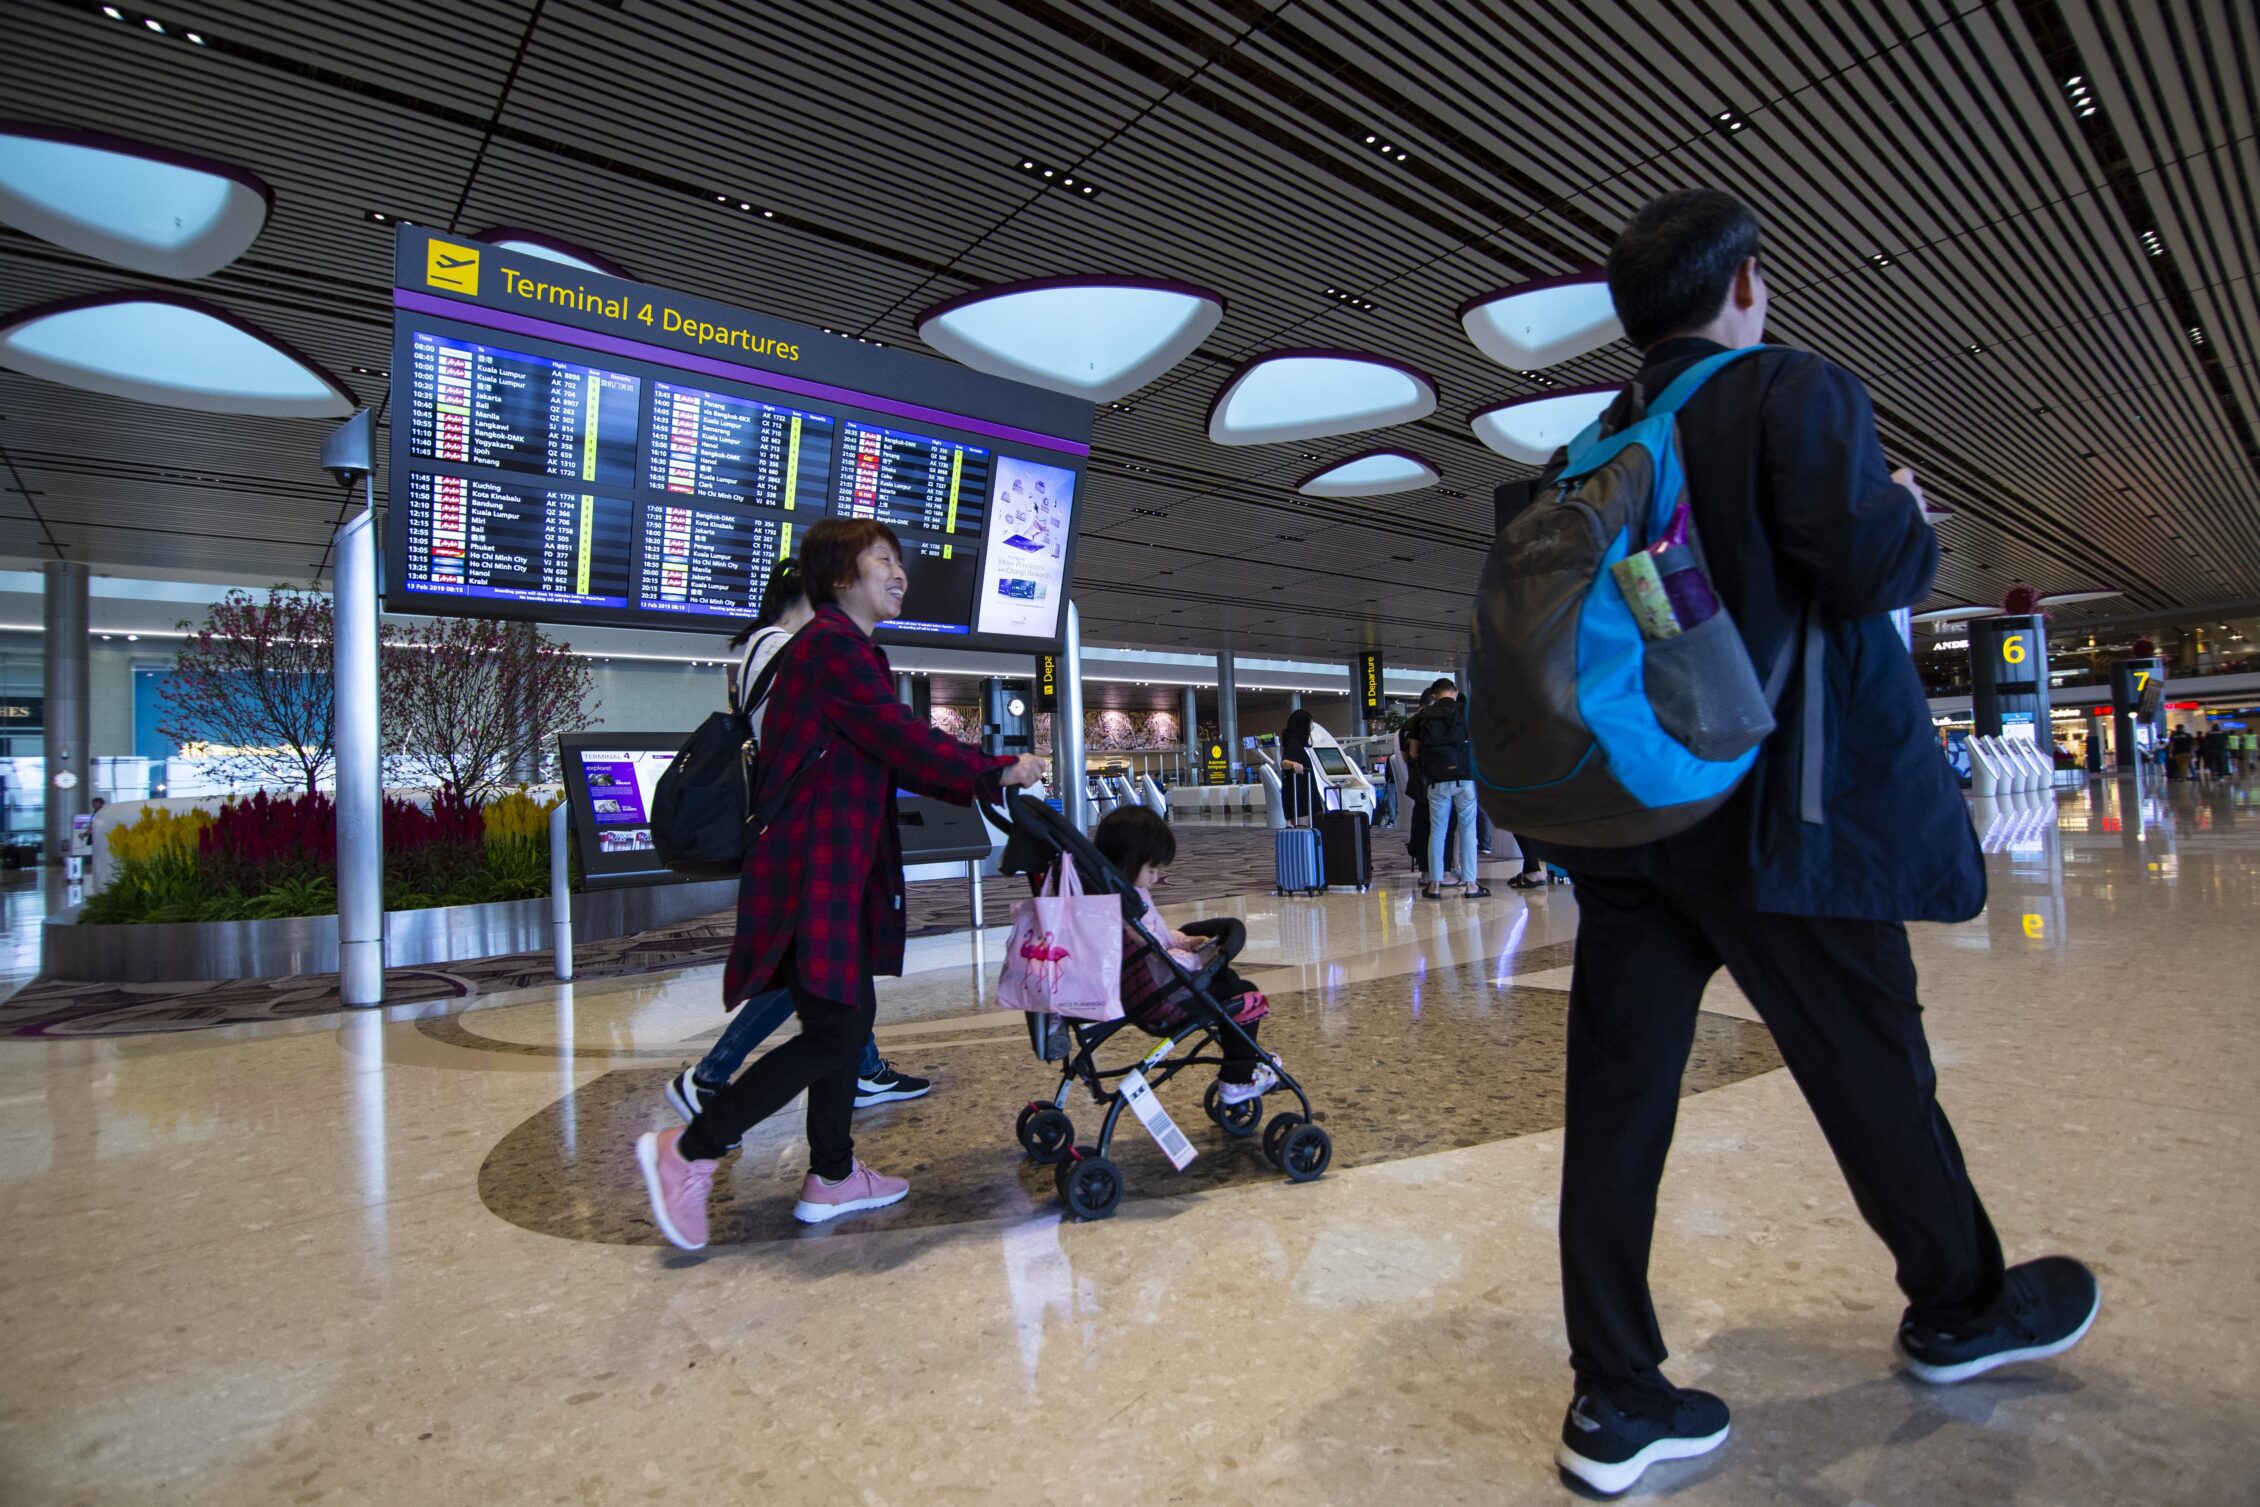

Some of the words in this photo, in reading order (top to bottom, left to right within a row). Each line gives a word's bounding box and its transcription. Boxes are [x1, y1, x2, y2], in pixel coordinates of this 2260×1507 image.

[500, 267, 628, 320] Terminal
[637, 304, 653, 326] 4
[663, 309, 799, 361] Departures
[414, 342, 435, 352] 08:00
[413, 351, 434, 361] 08:45
[476, 363, 497, 374] Kuala
[498, 368, 526, 379] Lumpur
[414, 361, 434, 371] 10:00
[476, 373, 497, 383] Kuala
[498, 377, 525, 388] Lumpur
[413, 371, 434, 380] 10:00
[413, 380, 433, 390] 10:20
[475, 391, 501, 402] Jakarta
[413, 390, 433, 399] 10:35
[475, 400, 489, 409] Bali
[412, 399, 432, 408] 10:40
[474, 410, 500, 420] Manila
[412, 409, 432, 418] 10:45
[474, 419, 509, 430] Langkawi
[411, 428, 432, 437] 11:10
[474, 437, 514, 449] Yogyakarta
[412, 418, 432, 427] 10:55
[474, 428, 524, 442] Bangkok-DMK
[411, 437, 431, 446] 11:40
[473, 446, 490, 455] Ipoh
[411, 446, 431, 455] 11:45
[472, 455, 500, 467] Penang
[410, 473, 430, 481] 11:45
[472, 481, 501, 492] Kuching
[410, 482, 430, 490] 11:45
[471, 490, 489, 498] Kota
[490, 492, 521, 502] Kinabalu
[409, 491, 430, 500] 11:50
[471, 498, 503, 510] Bandung
[409, 500, 429, 508] 12:10
[471, 508, 492, 516] Kuala
[492, 510, 520, 519] Lumpur
[409, 509, 429, 518] 12:15
[470, 516, 486, 524] Miri
[409, 518, 429, 526] 12:15
[408, 527, 428, 535] 12:55
[408, 536, 428, 544] 13:05
[469, 542, 495, 551] Phuket
[408, 545, 428, 553] 13:05
[513, 556, 527, 564] City
[408, 554, 428, 562] 13:15
[493, 562, 512, 570] Minh
[513, 564, 527, 572] City
[407, 563, 427, 571] 13:25
[468, 568, 490, 576] Hanoi
[407, 572, 427, 580] 13:40
[468, 577, 488, 585] Krabi
[2003, 635, 2025, 664] 6
[1368, 656, 1377, 697] Departure
[2133, 672, 2150, 691] 7
